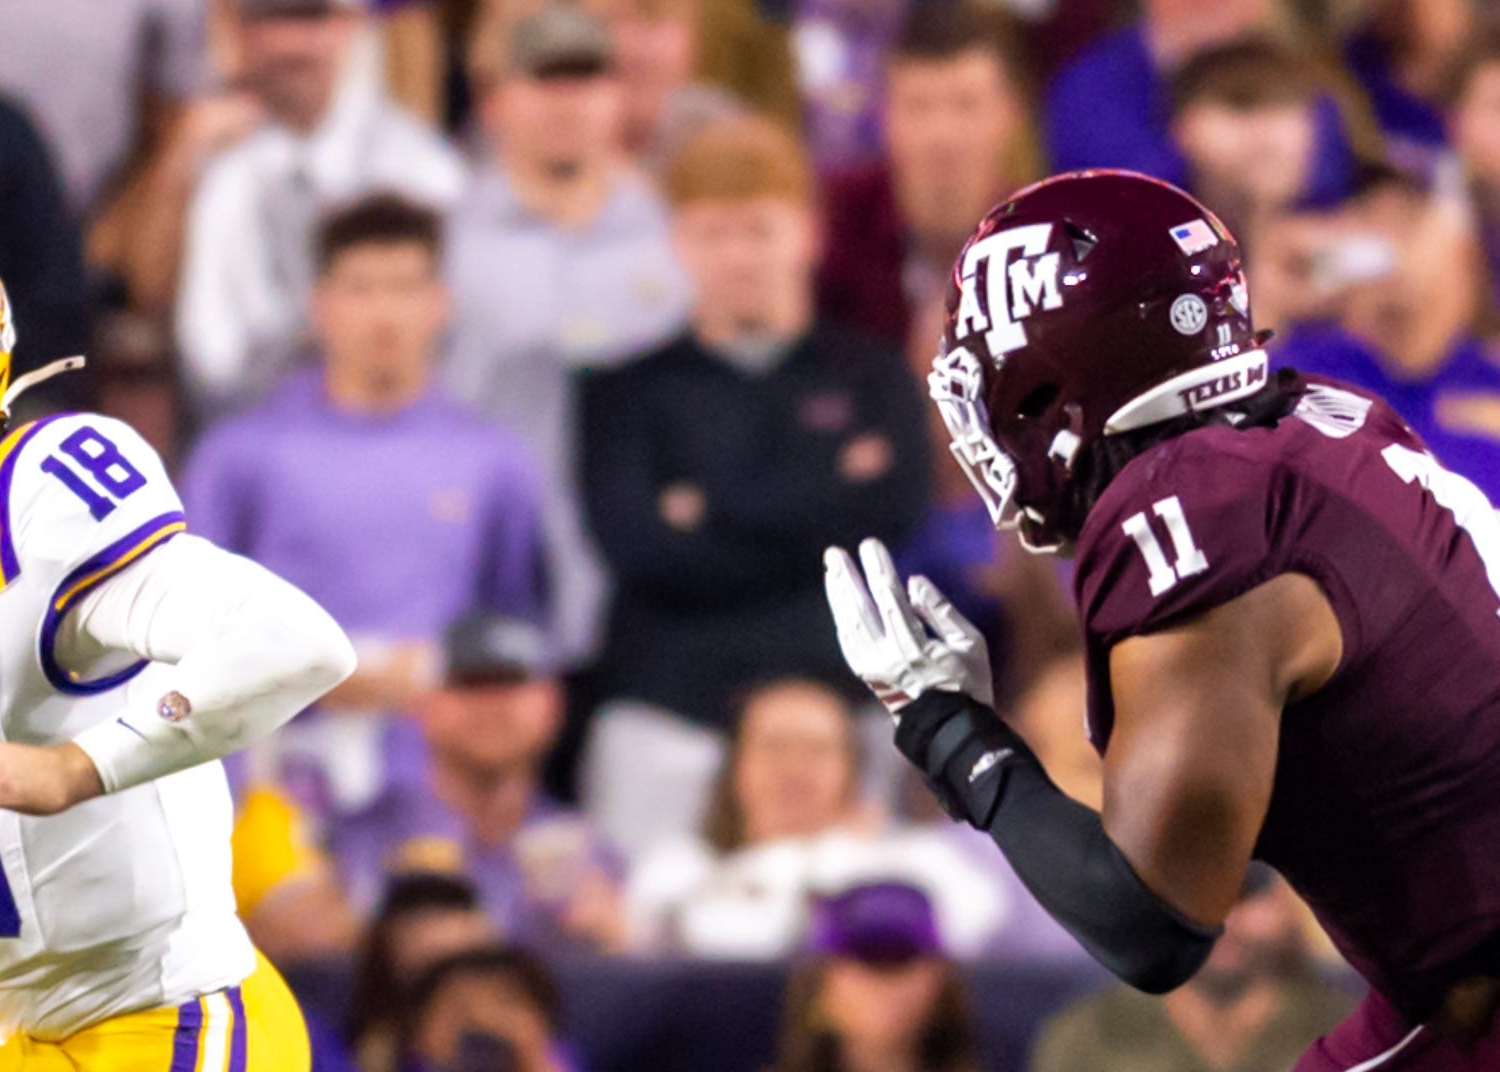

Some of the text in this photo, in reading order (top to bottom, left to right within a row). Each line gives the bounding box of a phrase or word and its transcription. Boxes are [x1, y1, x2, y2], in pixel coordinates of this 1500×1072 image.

[1178, 370, 1242, 412] TEXAS
[40, 425, 147, 522] 18
[1122, 495, 1209, 598] 11
